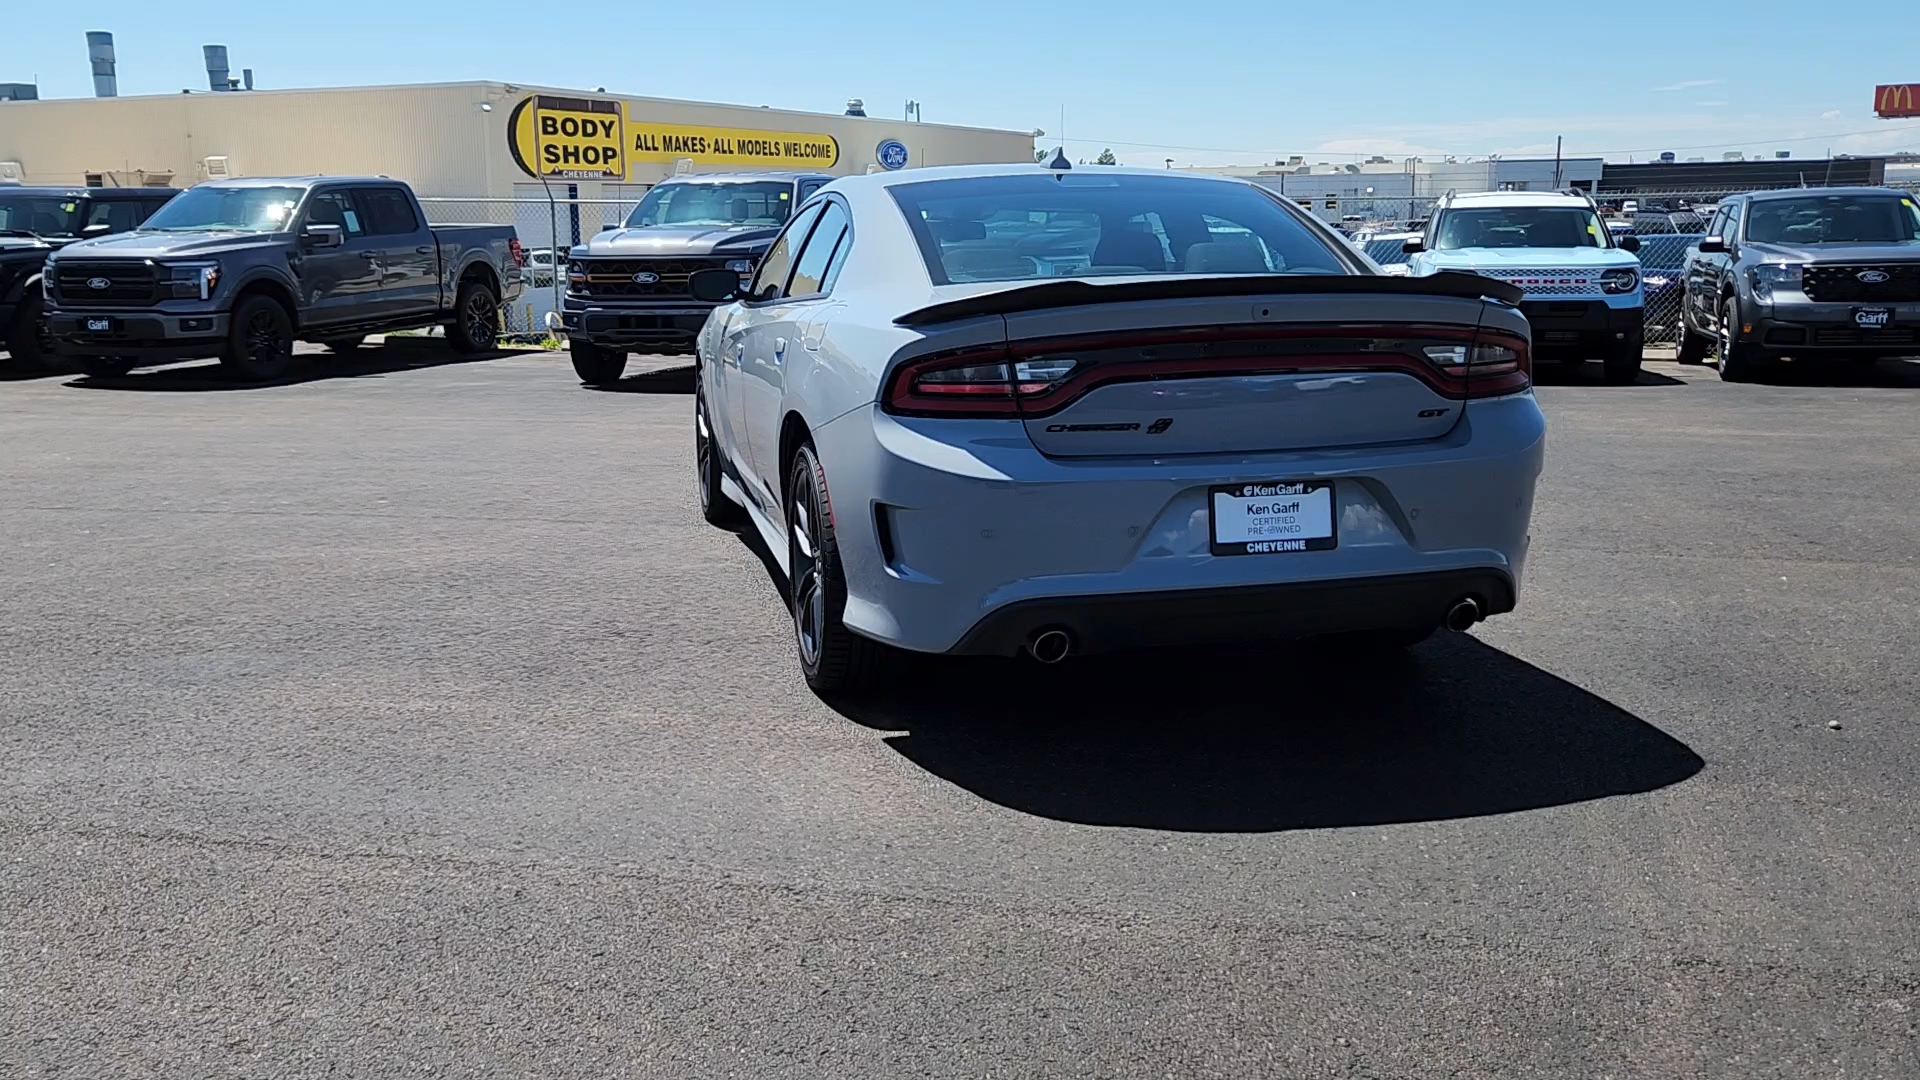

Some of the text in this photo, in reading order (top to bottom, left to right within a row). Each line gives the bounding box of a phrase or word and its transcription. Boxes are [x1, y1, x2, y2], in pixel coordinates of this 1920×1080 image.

[541, 116, 616, 139] BODY
[635, 133, 832, 159] ALL MAKES ALL MODELS WELCOME
[543, 144, 618, 165] SHOP
[562, 170, 604, 178] CHEYENNE
[1855, 312, 1889, 324] Garff
[1417, 408, 1451, 418] GT
[1253, 483, 1304, 496] Ken Garff
[1247, 501, 1300, 515] Ken Garff
[1252, 516, 1296, 526] CERTIFIED
[1246, 540, 1307, 553] CHEYENNE
